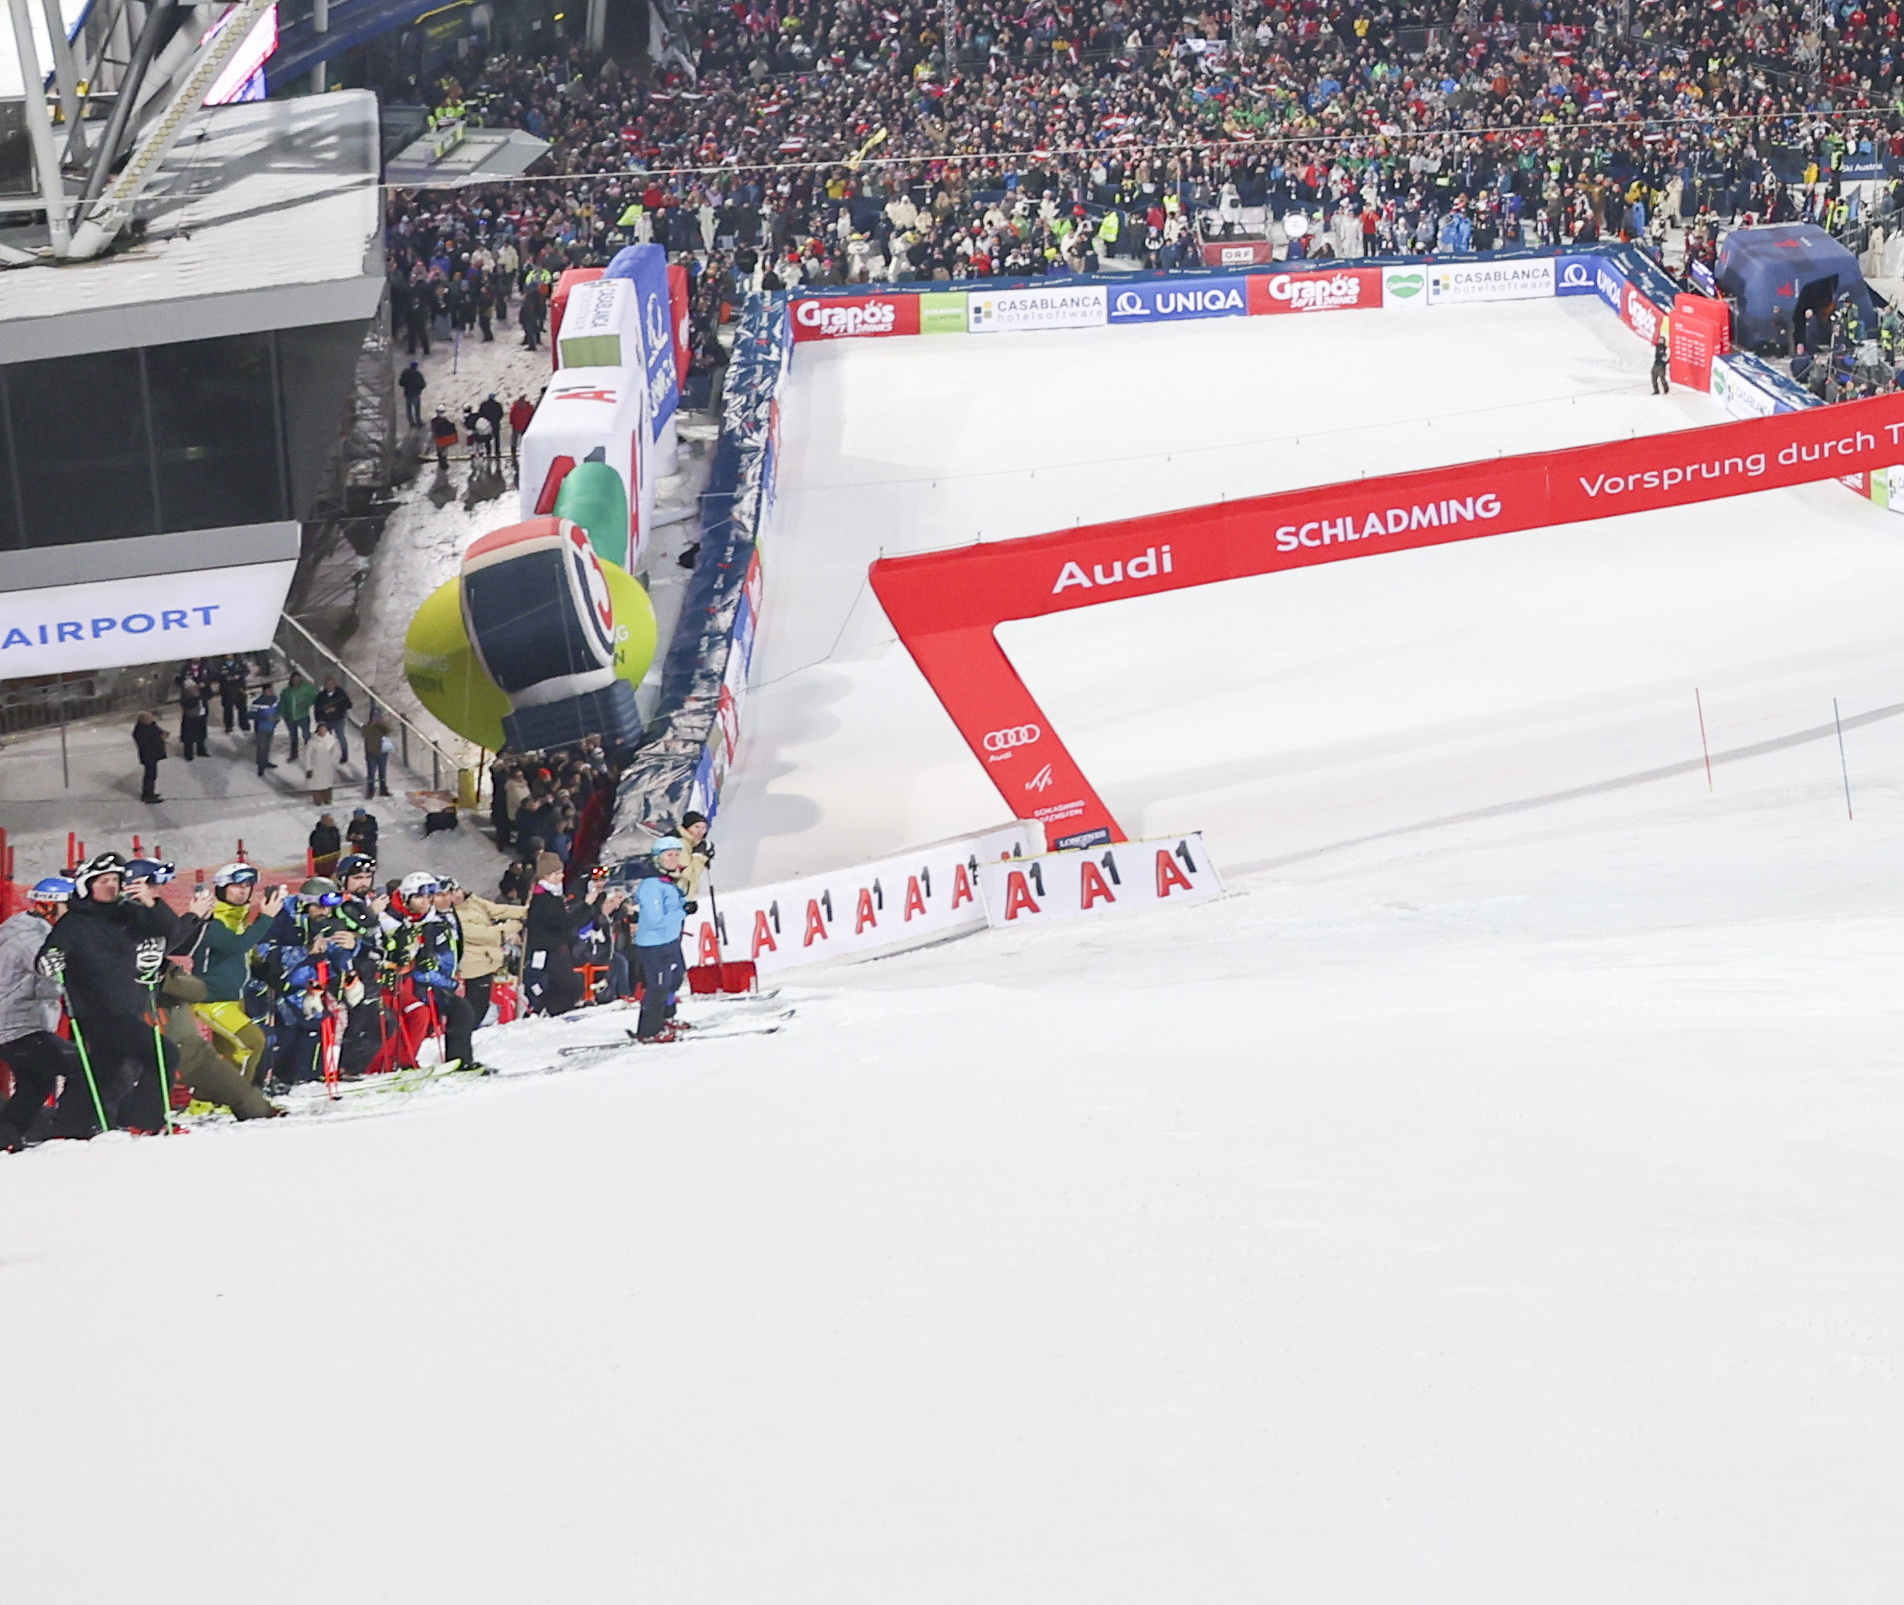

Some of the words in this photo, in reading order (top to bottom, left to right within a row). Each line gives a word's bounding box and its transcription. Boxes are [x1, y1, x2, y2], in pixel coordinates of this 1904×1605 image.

[1224, 249, 1251, 260] ORF
[1454, 267, 1551, 285] CASABLANCA
[1454, 280, 1552, 294] hotelsoftware
[997, 296, 1102, 312] CASABLANCA
[997, 308, 1104, 323] hotelsoftware
[1155, 289, 1245, 314] UNIQA
[1580, 452, 1766, 498] Vorsprung
[1778, 429, 1875, 465] durch
[1275, 492, 1503, 551] SCHLADMING
[1052, 544, 1175, 594] Audi
[2, 605, 221, 650] AIRPORT
[1005, 861, 1045, 920] A1
[1081, 849, 1121, 910] A1
[1156, 839, 1197, 898] A1
[752, 899, 781, 958] A1
[804, 888, 833, 946] A1
[855, 877, 882, 934] A1
[904, 864, 931, 922] A1
